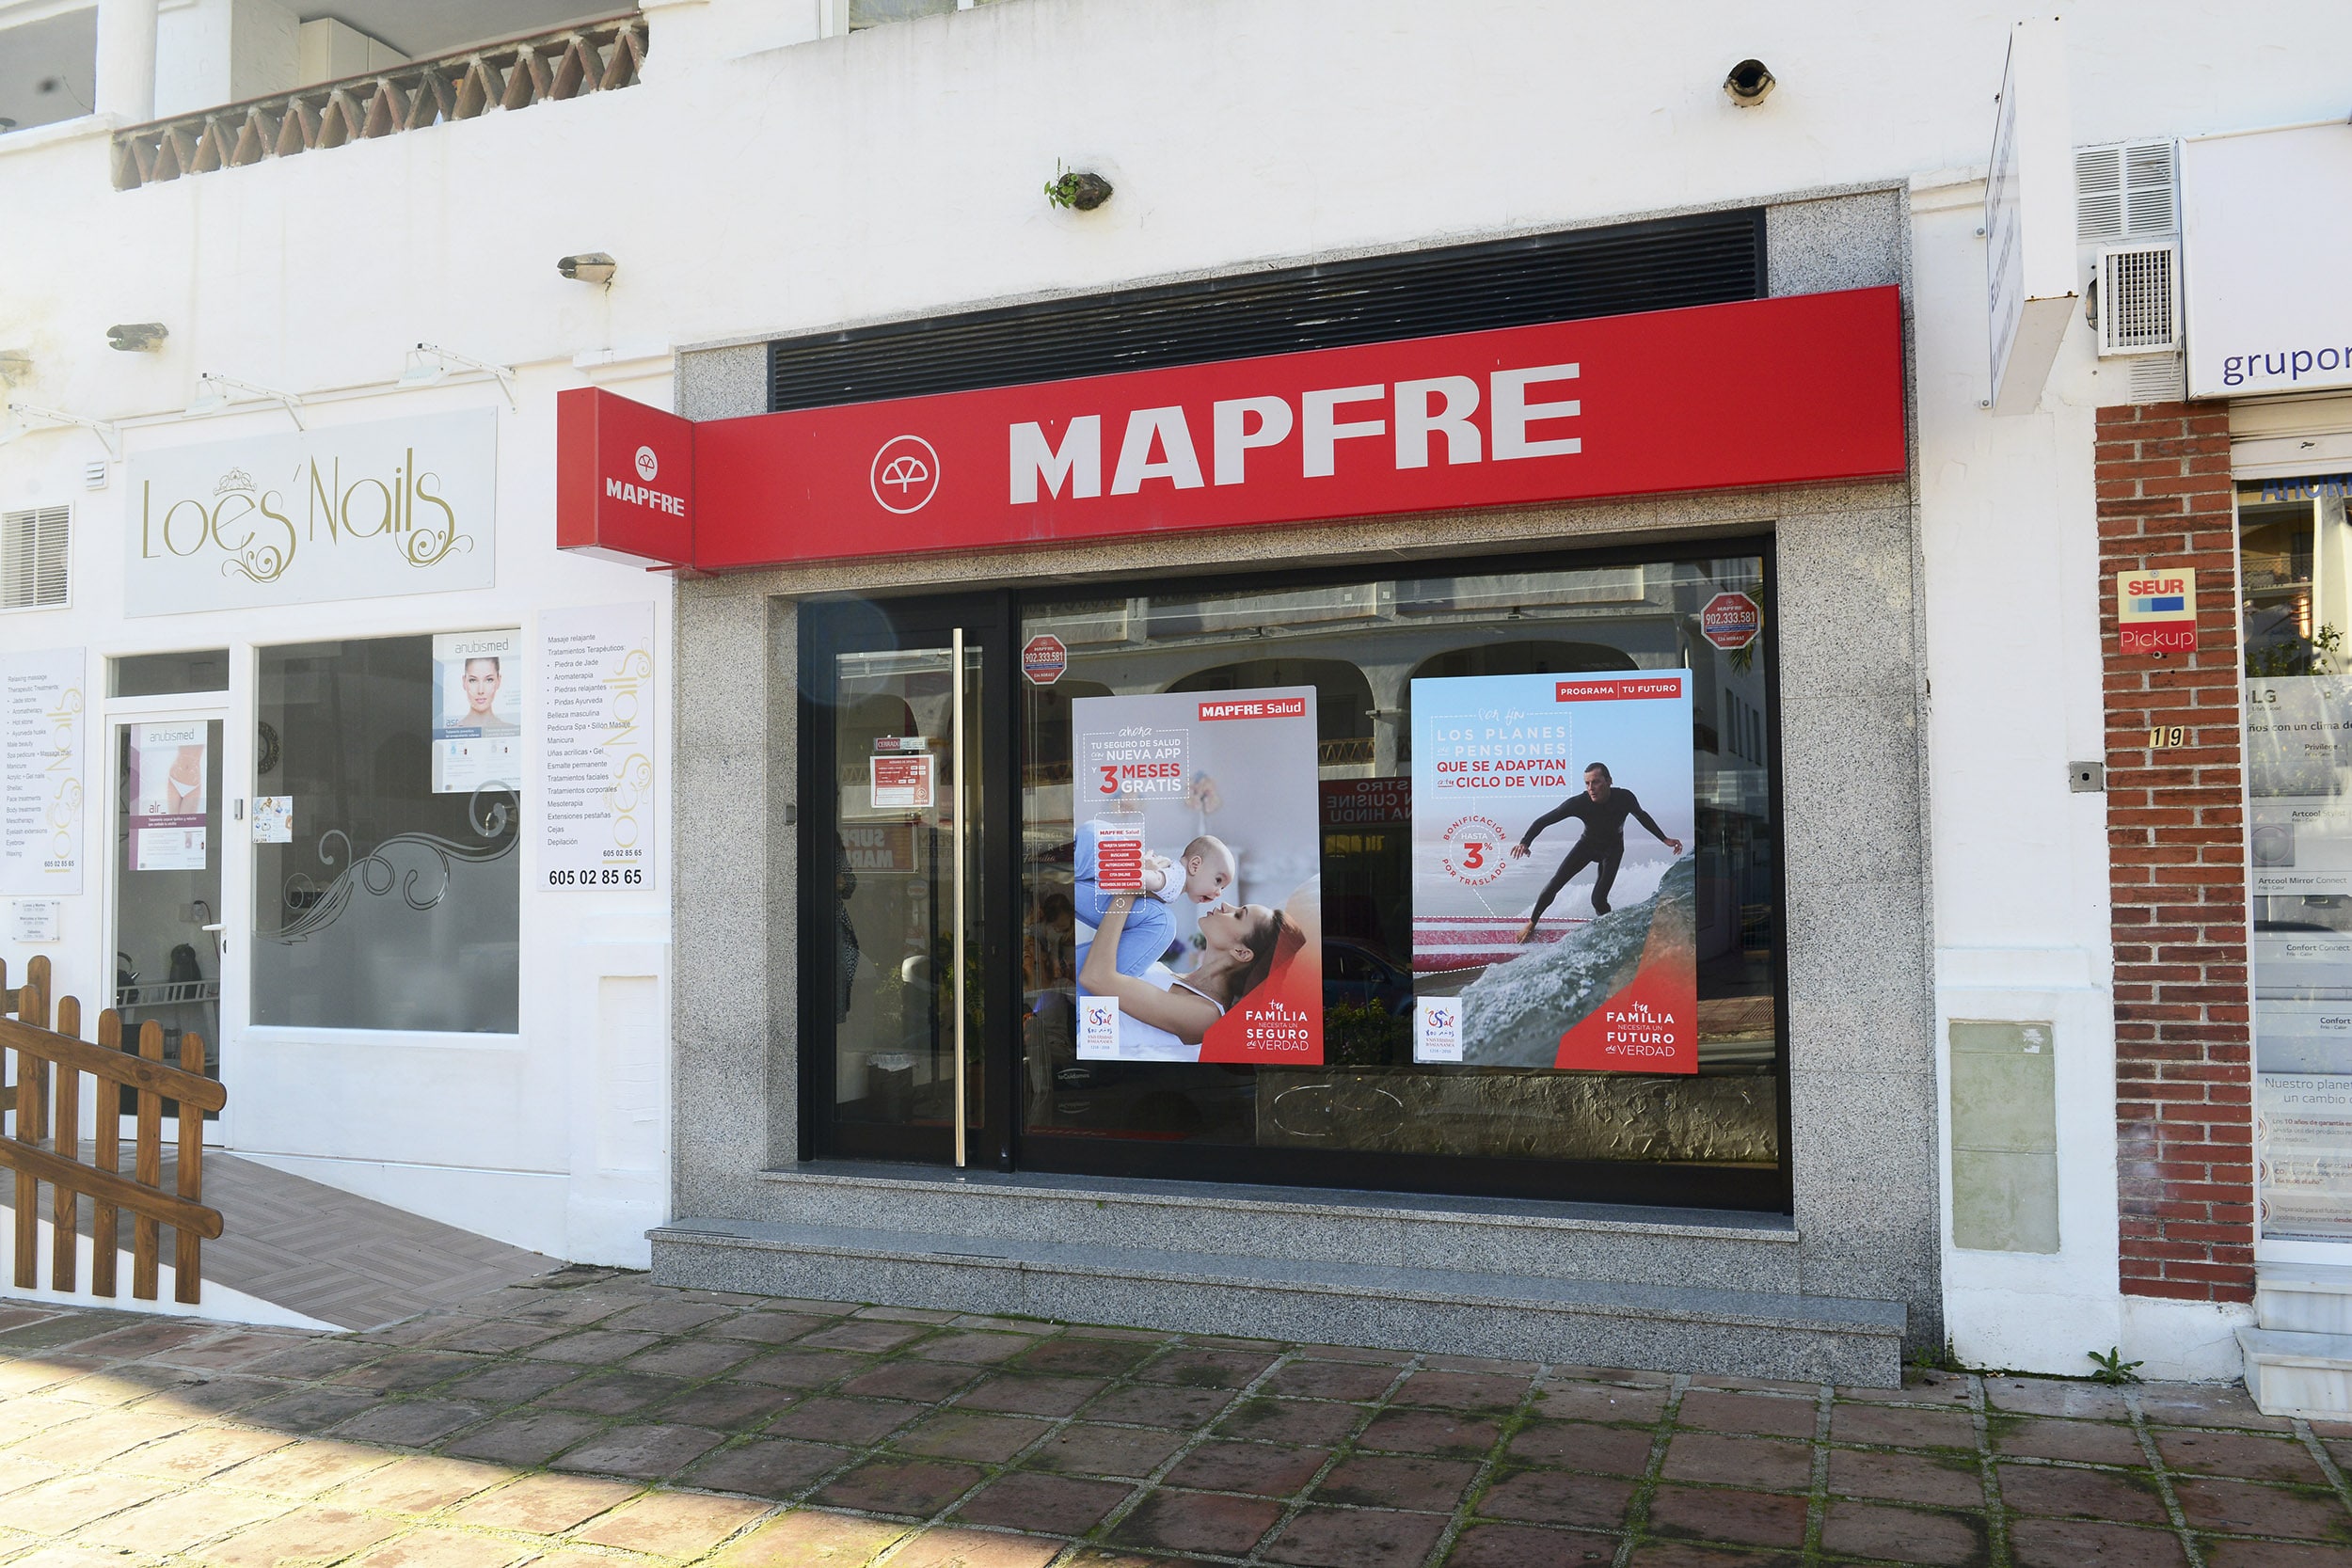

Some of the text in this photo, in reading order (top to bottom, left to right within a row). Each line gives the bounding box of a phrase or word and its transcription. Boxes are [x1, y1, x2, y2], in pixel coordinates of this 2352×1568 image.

[1009, 362, 1582, 505] MAPFRE
[606, 477, 685, 517] MAPFRE
[142, 479, 296, 583] Loes
[2128, 578, 2184, 595] SEUR
[1706, 611, 1756, 625] 902.333.581
[548, 634, 596, 644] Masaje relajante
[2121, 629, 2194, 649] Pickup
[454, 639, 509, 654] anubismed
[548, 647, 585, 656] Tratamientos
[1025, 652, 1063, 662] 902.333.581
[554, 673, 594, 681] Aromaterapia
[578, 684, 607, 693] relajantes
[1560, 687, 1614, 696] PROGRAMA
[1637, 684, 1677, 693] FUTURO
[575, 697, 603, 706] Ayurveda
[2251, 689, 2277, 704] LG
[1202, 701, 1301, 717] MAPFRE Salud
[547, 711, 569, 720] Belleza
[547, 723, 574, 732] Pedicura
[574, 722, 587, 731] Spa
[609, 721, 631, 729] Masaje
[1118, 726, 1152, 737] ahora
[2272, 723, 2291, 732] con
[2311, 721, 2340, 730] clima
[150, 728, 195, 742] anubismed
[1437, 726, 1566, 741] LOS PLANES
[2153, 727, 2182, 747] 19
[1104, 740, 1137, 749] SEGURO
[1139, 739, 1151, 748] DE
[1152, 738, 1181, 747] SALUD
[2304, 743, 2338, 752] Privilege
[547, 749, 563, 757] Uñas
[1106, 748, 1182, 761] NUEVA APP
[1454, 743, 1566, 757] PENSIONES
[572, 761, 608, 770] permanente
[1437, 758, 1566, 773] QUE SE ADAPTAN
[547, 773, 585, 783] Tratamientos
[1099, 765, 1119, 794] 3
[1121, 763, 1181, 779] MESES
[1455, 776, 1501, 788] CICLO
[1505, 776, 1525, 787] DE
[1529, 775, 1566, 786] VIDA
[547, 785, 618, 795] Tratamientos corporales
[1120, 778, 1182, 794] GRATIS
[547, 800, 583, 809] Mesoterapia
[583, 811, 612, 820] pestañas
[547, 825, 564, 833] Cejas
[547, 837, 579, 847] Depilación
[1442, 858, 1457, 878] POR
[548, 868, 643, 886] 605 02 85 65
[2286, 943, 2317, 952] Confort
[1268, 999, 1284, 1012] tu
[1631, 1001, 1648, 1014] tu
[1245, 1010, 1308, 1022] FAMILIA
[1606, 1011, 1675, 1024] FAMILIA
[1246, 1029, 1309, 1039] SEGURO
[1606, 1032, 1675, 1044] FUTURO
[1257, 1040, 1310, 1052] VERDAD
[1605, 1044, 1676, 1057] de VERDAD
[2265, 1077, 2314, 1089] Nuestro
[2283, 1095, 2298, 1103] un
[2302, 1093, 2345, 1104] cambio
